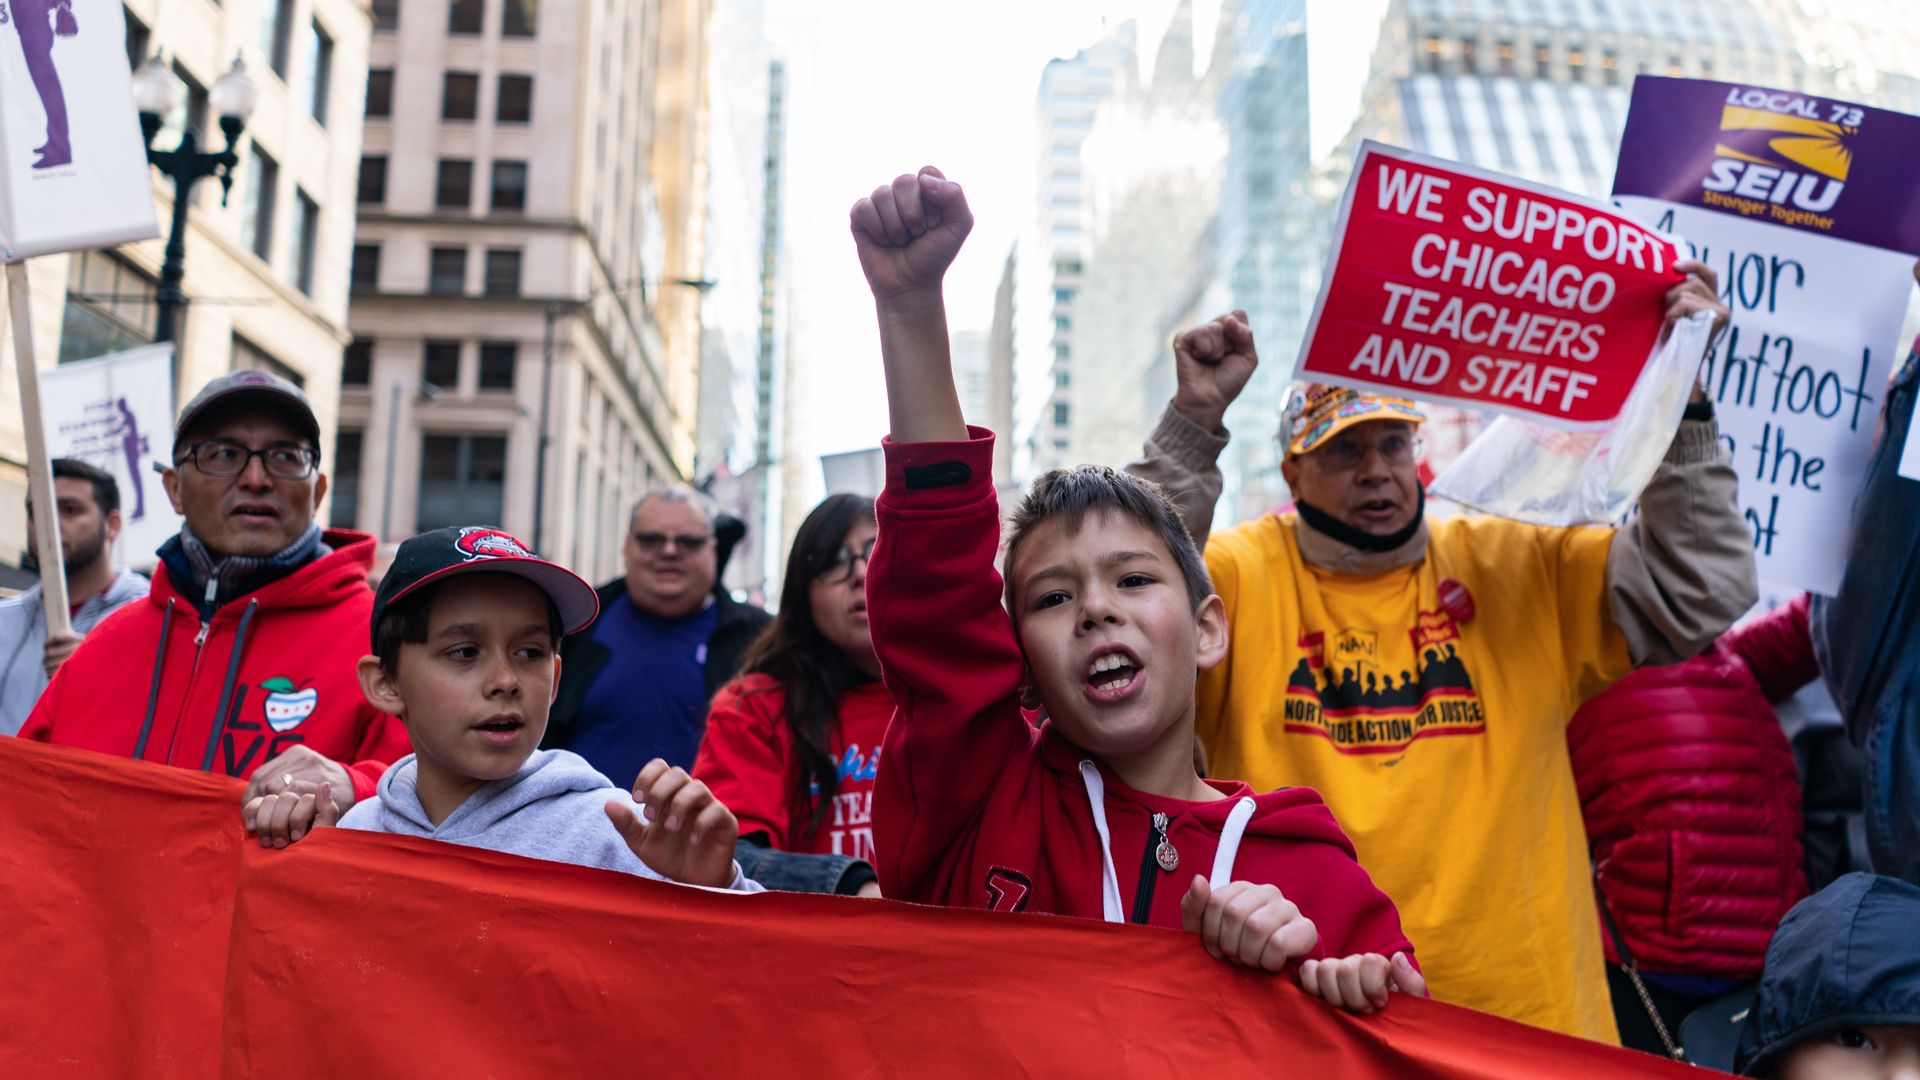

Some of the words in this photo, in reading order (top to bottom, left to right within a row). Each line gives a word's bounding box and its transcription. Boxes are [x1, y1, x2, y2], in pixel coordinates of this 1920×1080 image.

[1726, 88, 1820, 119] LOCAL
[1829, 104, 1865, 127] 73
[1377, 163, 1452, 224] WE
[1462, 186, 1664, 275] SUPPORT
[1702, 159, 1845, 213] SEIU
[1703, 189, 1767, 217] Stronger
[1770, 202, 1835, 231] Together
[1411, 233, 1616, 314] CHICAGO
[1381, 282, 1606, 363] TEACHERS
[1348, 334, 1452, 386] AND
[1459, 355, 1598, 413] STAFF
[1752, 421, 1825, 491] the
[1355, 718, 1413, 745] ACTION
